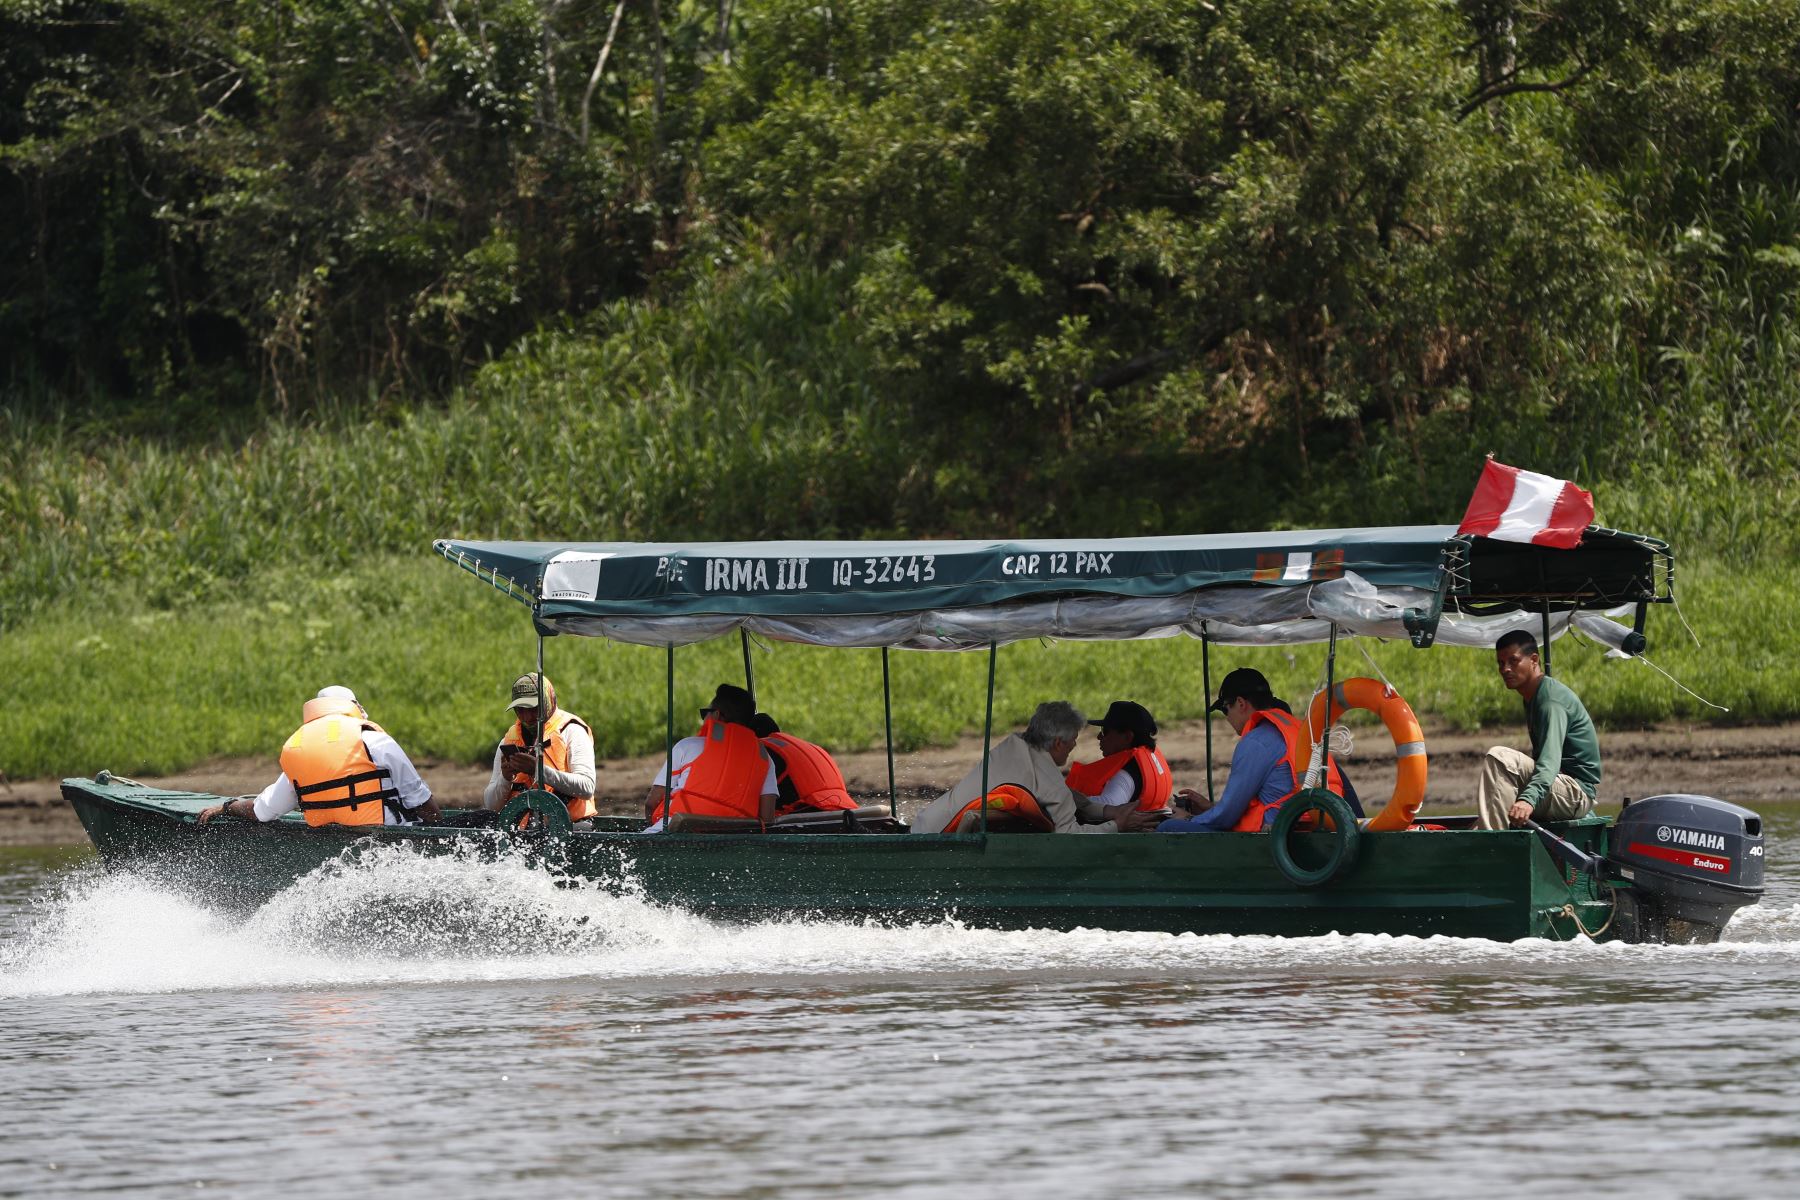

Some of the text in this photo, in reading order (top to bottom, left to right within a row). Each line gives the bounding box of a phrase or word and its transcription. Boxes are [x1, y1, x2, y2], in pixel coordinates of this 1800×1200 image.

[705, 558, 770, 592] IRMA
[775, 558, 810, 590] III
[832, 554, 936, 587] IQ-32643
[1002, 551, 1115, 575] CAP. 12 PAX
[1672, 828, 1725, 851] YAMAHA
[1749, 846, 1763, 857] 40
[1693, 857, 1724, 870] Enduro
